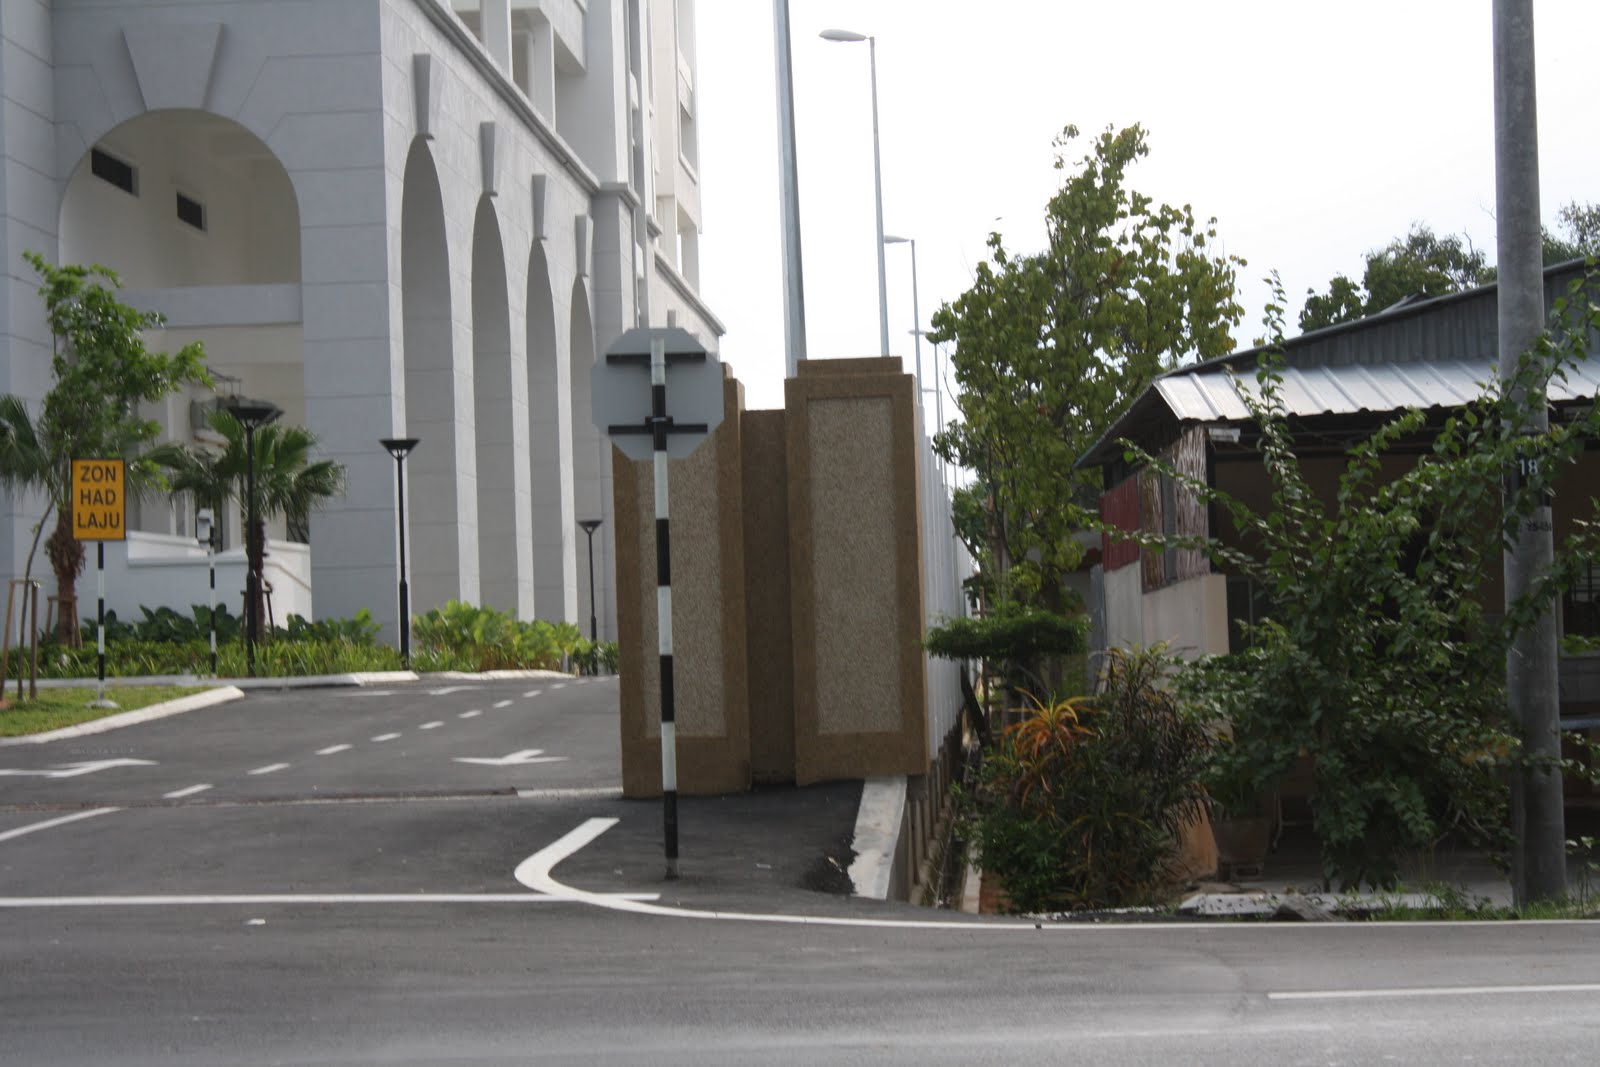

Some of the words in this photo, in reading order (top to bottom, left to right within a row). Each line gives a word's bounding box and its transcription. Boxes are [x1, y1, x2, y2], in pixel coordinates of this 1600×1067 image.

[80, 465, 116, 482] ZON
[1519, 458, 1538, 476] 18
[80, 489, 116, 506] HAD
[78, 512, 120, 529] LAJU
